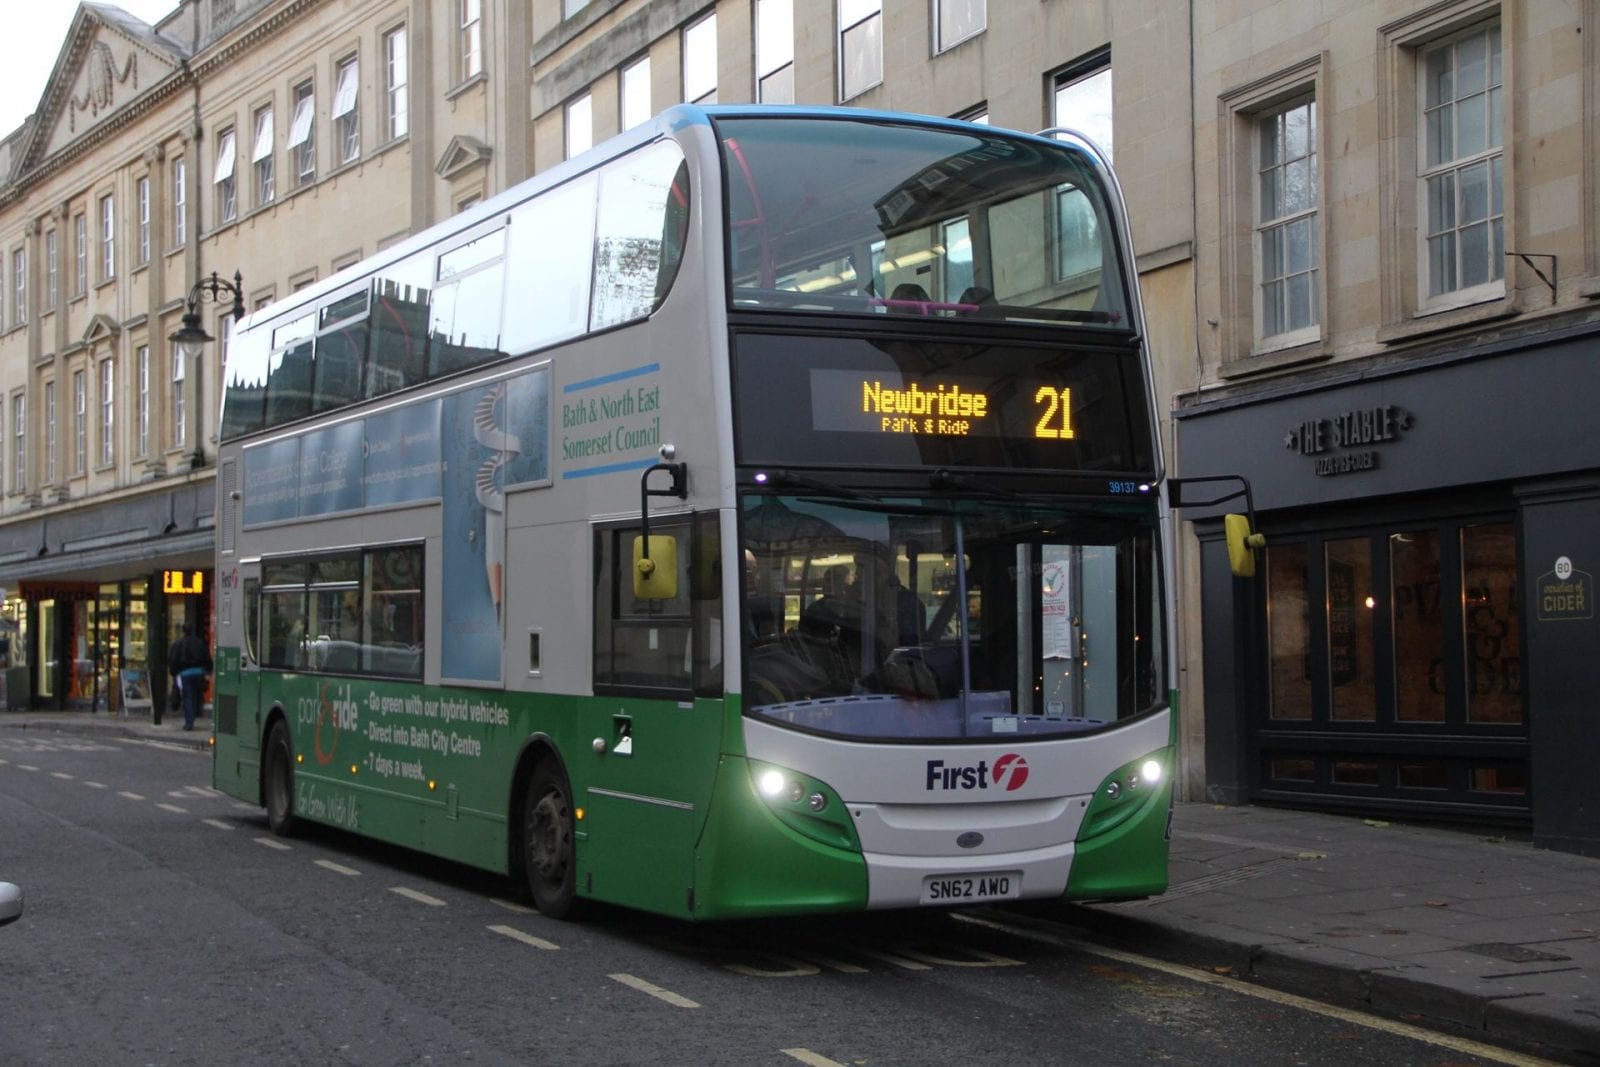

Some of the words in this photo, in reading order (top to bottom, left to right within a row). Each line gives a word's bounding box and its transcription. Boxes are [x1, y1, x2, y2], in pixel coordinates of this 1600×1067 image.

[563, 399, 587, 427] Bath
[589, 398, 597, 422] &
[600, 389, 634, 420] North
[638, 386, 660, 413] East
[864, 381, 988, 417] Newbridge
[1035, 386, 1074, 439] 21
[563, 430, 612, 460] Somerset
[616, 417, 660, 451] Council
[882, 418, 919, 433] Park
[924, 419, 934, 434] &
[939, 420, 971, 435] Ride
[1297, 418, 1325, 455] THE
[1332, 404, 1394, 447] STABLE
[1109, 481, 1136, 494] 39137
[1557, 562, 1570, 574] 80
[1544, 595, 1585, 612] CIDER
[333, 684, 358, 731] ride
[369, 690, 380, 710] Go
[382, 696, 404, 716] green
[405, 694, 423, 716] with
[424, 701, 439, 717] our
[440, 697, 468, 723] hybrid
[470, 701, 509, 726] vehicles
[369, 721, 392, 743] Direct
[393, 726, 409, 745] into
[410, 726, 430, 748] Bath
[431, 728, 449, 756] City
[450, 731, 481, 757] Centre
[369, 752, 375, 771] 7
[375, 754, 394, 777] days
[394, 762, 400, 775] a
[401, 760, 426, 781] week.
[927, 760, 988, 790] First
[930, 879, 973, 899] SN62
[978, 877, 1010, 897] AWO
